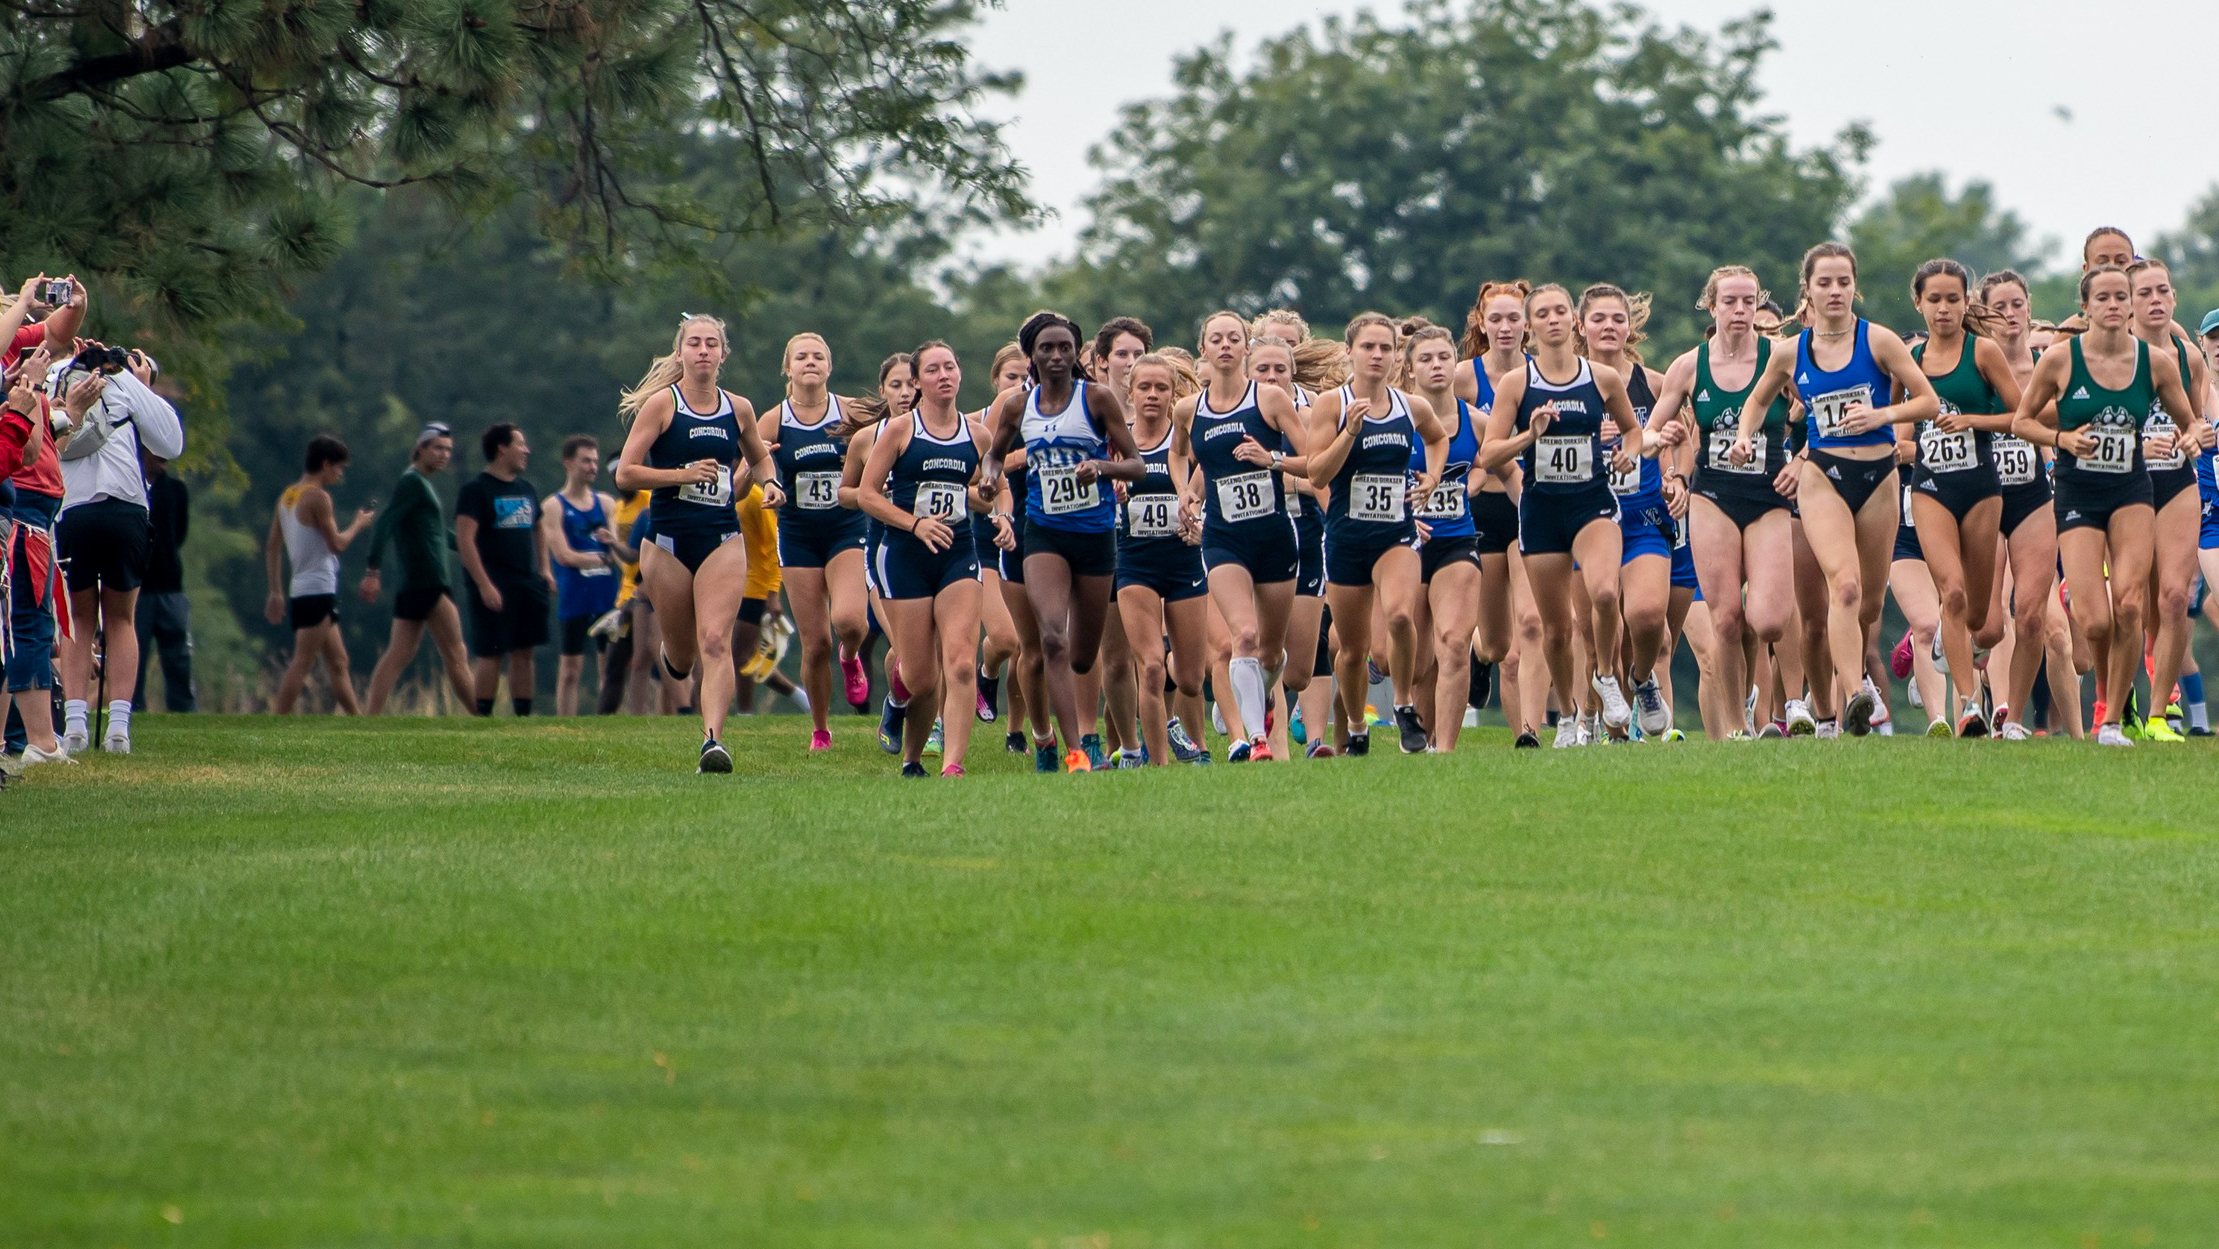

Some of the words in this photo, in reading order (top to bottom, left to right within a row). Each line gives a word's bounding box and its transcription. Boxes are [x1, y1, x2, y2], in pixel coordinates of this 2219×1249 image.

[689, 426, 729, 440] CONCORDIA
[1204, 422, 1246, 441] CONCORDIA
[1362, 432, 1409, 450] CONCORDIA
[794, 443, 838, 460] CONCORDIA
[1550, 447, 1578, 473] 40
[1926, 435, 1967, 464] 263
[2089, 435, 2126, 463] 261
[922, 458, 967, 473] CONCORDIA
[1992, 450, 2029, 475] 259
[809, 479, 832, 502] 43
[1232, 482, 1261, 511] 38
[1365, 485, 1392, 511] 35
[929, 491, 954, 516] 58
[1142, 504, 1168, 528] 49
